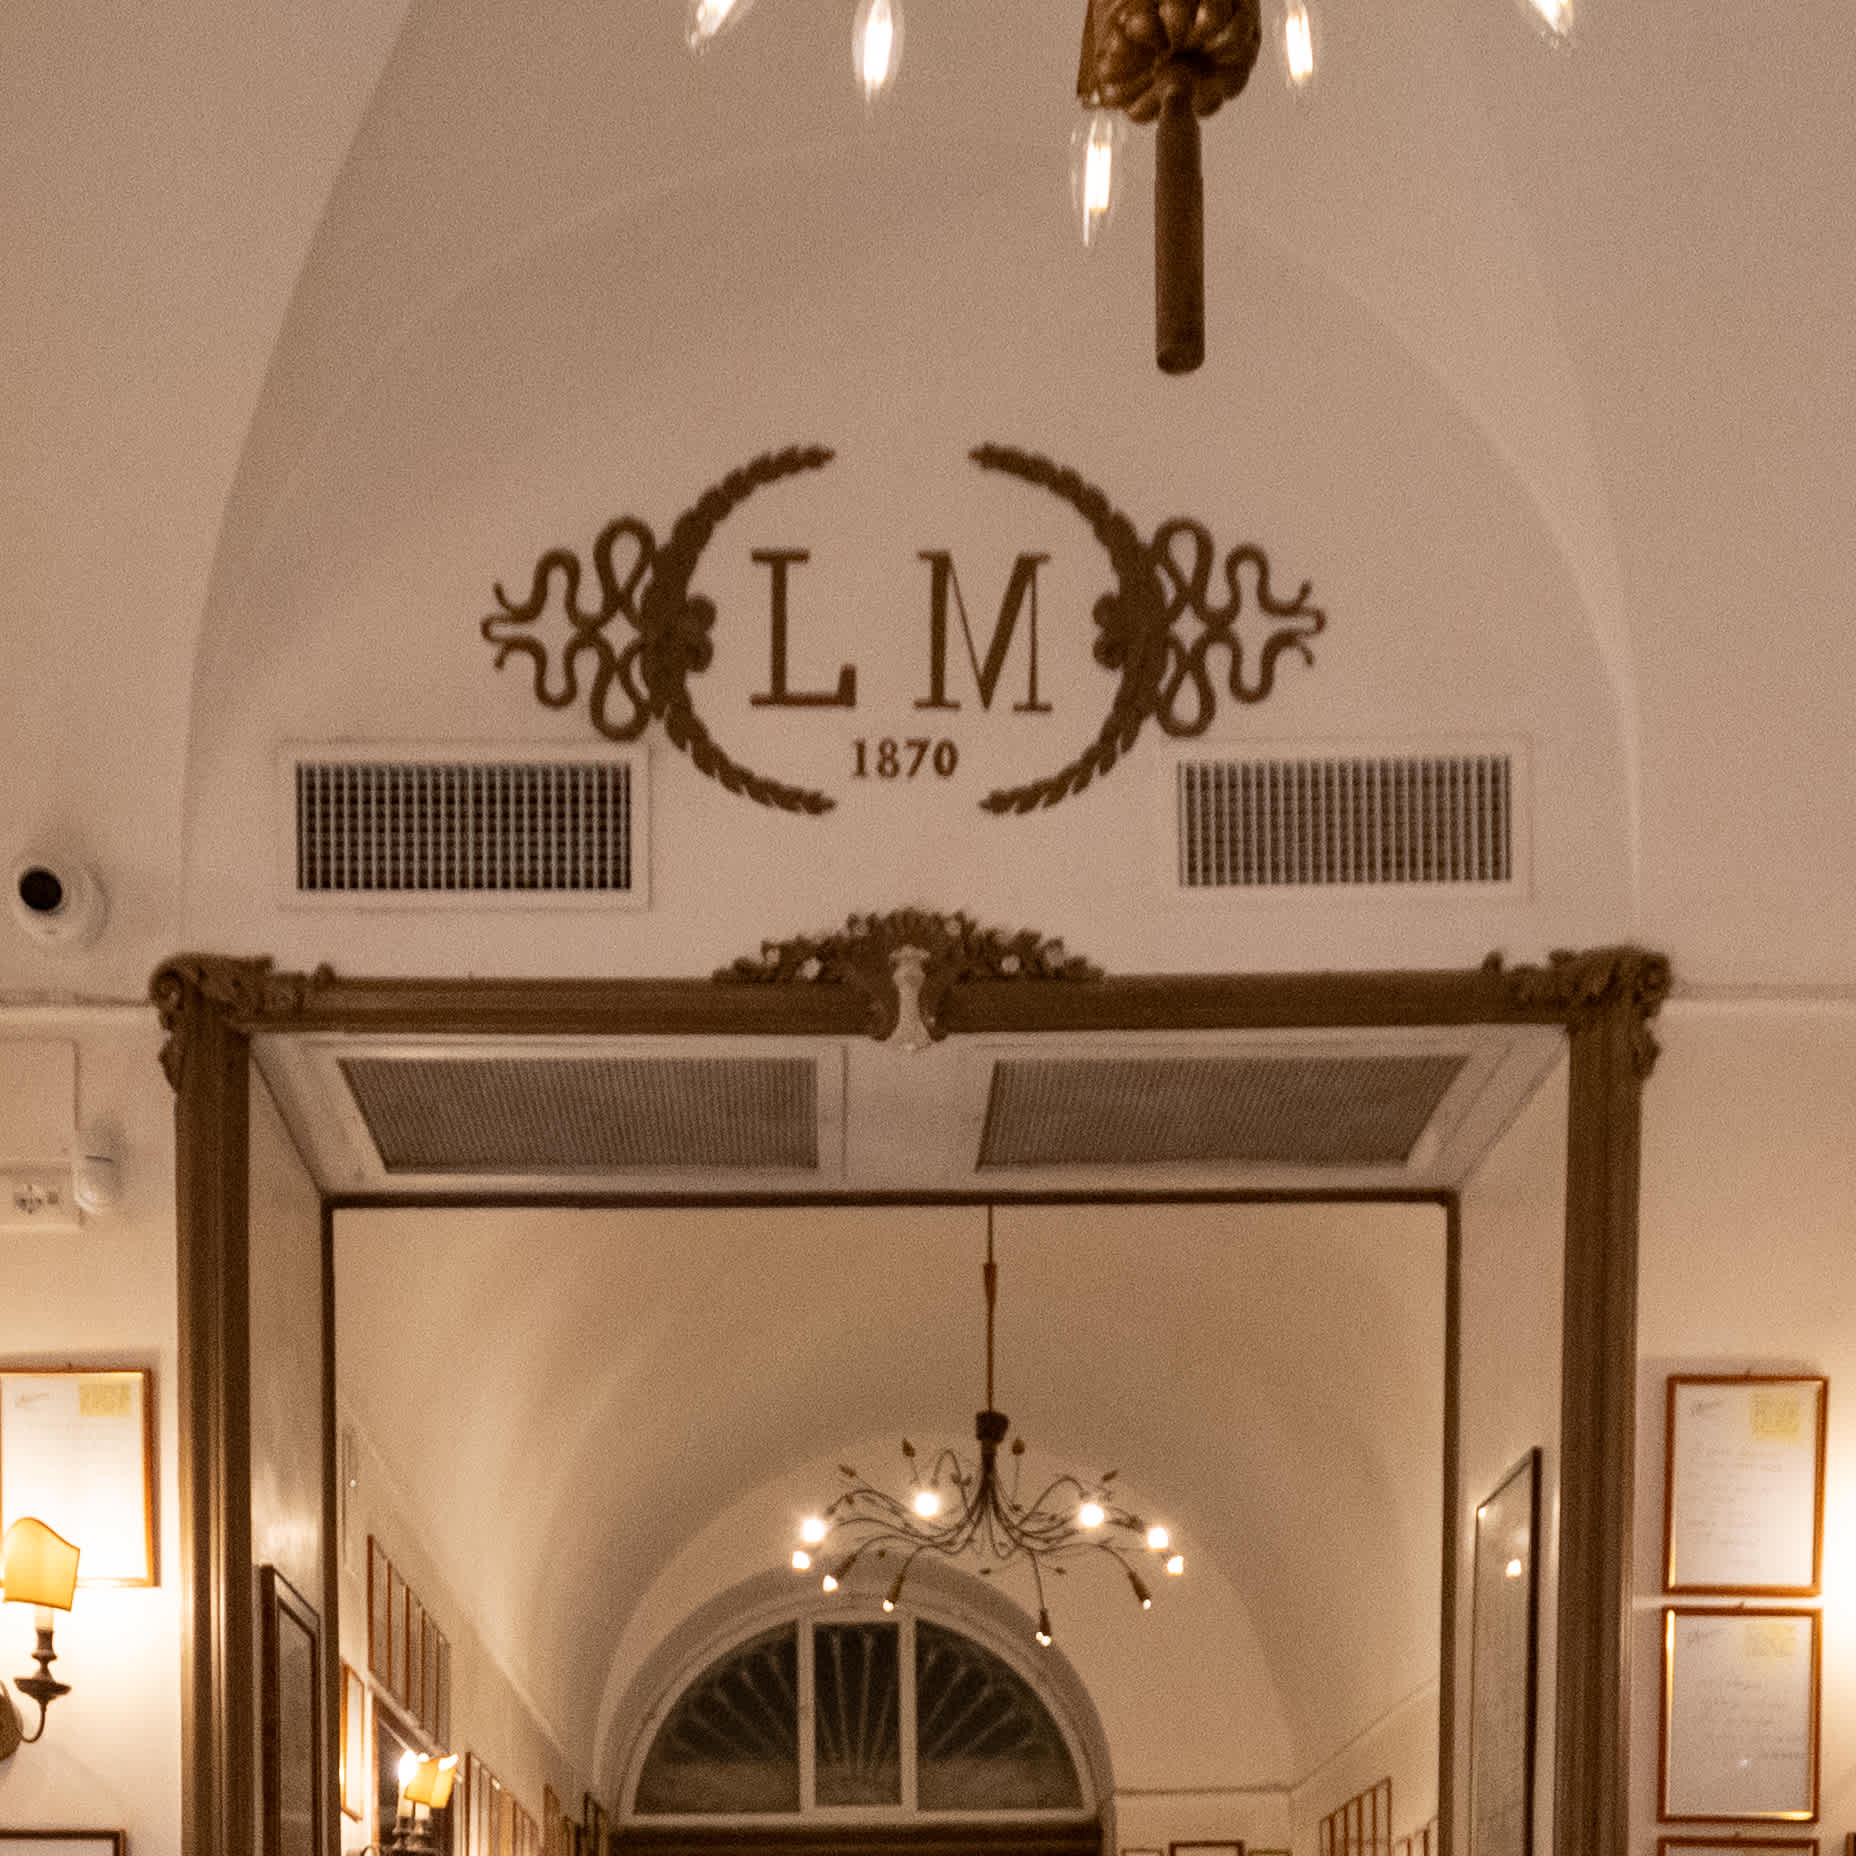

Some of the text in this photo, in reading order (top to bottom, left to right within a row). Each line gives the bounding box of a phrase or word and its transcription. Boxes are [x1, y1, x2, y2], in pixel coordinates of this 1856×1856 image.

[749, 548, 1053, 712] L M
[852, 737, 959, 778] 1870
